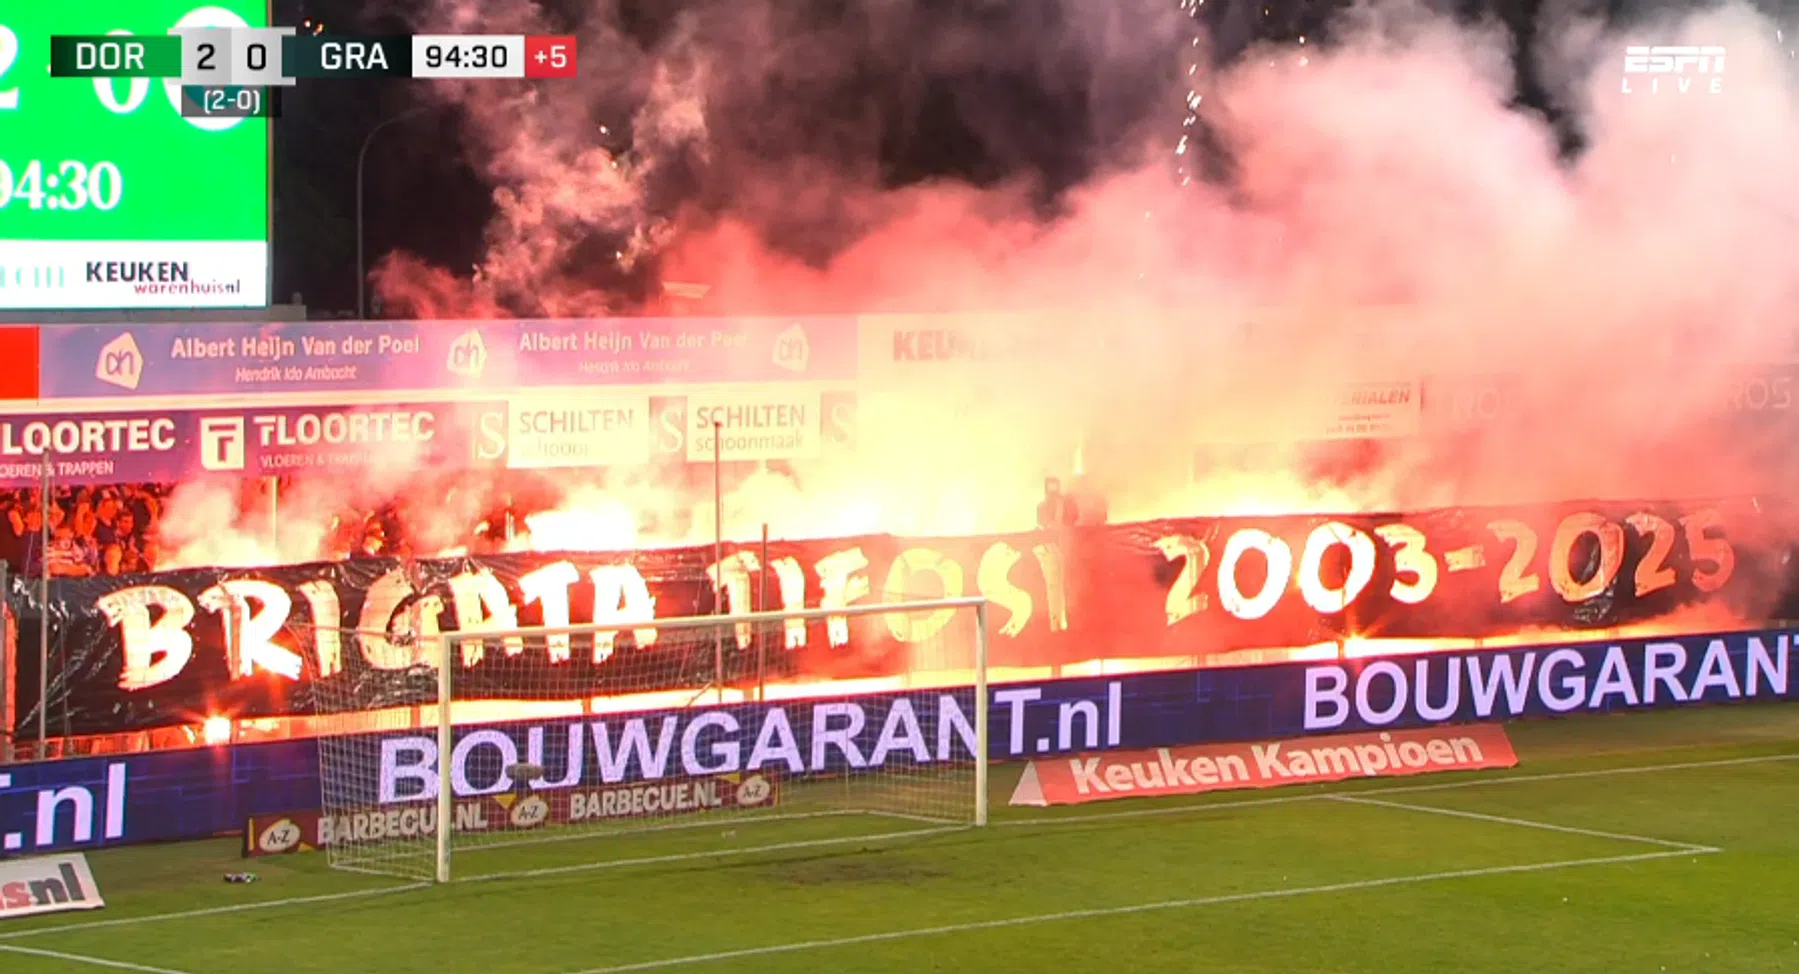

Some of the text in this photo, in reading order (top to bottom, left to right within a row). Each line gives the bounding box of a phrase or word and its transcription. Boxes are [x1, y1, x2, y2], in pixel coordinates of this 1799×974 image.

[86, 261, 189, 282] KEUKEN
[171, 334, 421, 361] Albert Heijn Van der Poel
[520, 332, 578, 351] Albert
[584, 331, 633, 355] Heijn
[639, 331, 671, 349] Van
[676, 331, 706, 349] der
[235, 367, 281, 383] Hendrik
[305, 364, 357, 381] Ambacht
[253, 411, 435, 447] FLOORTEC
[519, 409, 634, 434] SCHILTEN
[696, 404, 805, 429] SCHILTEN
[695, 430, 804, 453] schoonmaak
[58, 461, 114, 476] TRAPPEN
[98, 508, 1736, 692] BRIGATA TIFOSI 2003-2025
[1304, 634, 1799, 730] BOUWGARAN
[377, 681, 1122, 805] BOUWGARANT.nl
[1070, 732, 1483, 795] Keuken Kampioen
[0, 762, 126, 849] .nl
[318, 802, 489, 845] BARBECU.NL
[570, 781, 722, 821] BARBECUE.NL
[0, 862, 85, 909] snl
